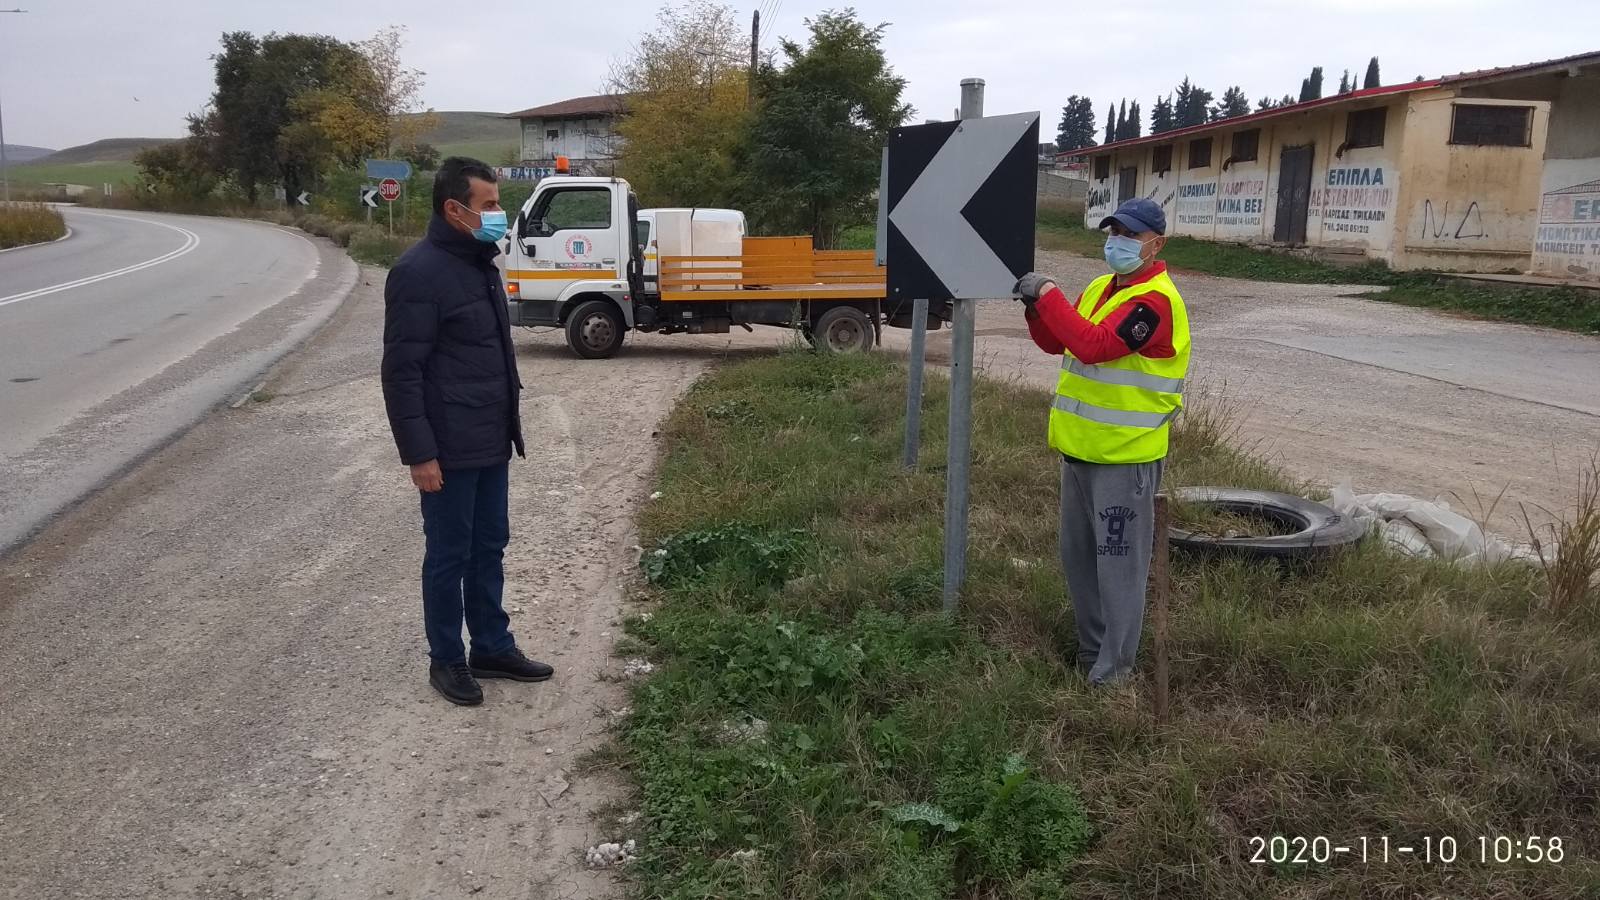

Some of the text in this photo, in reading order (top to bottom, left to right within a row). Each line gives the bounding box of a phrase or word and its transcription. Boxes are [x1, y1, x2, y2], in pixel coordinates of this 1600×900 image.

[1328, 168, 1384, 186] ΕΠΙΠΛΑ
[381, 183, 398, 195] STOP
[1217, 199, 1241, 213] ΚΛΙΜΑ
[1352, 209, 1386, 222] ΤΡΙΚΑΛΩΝ
[1098, 505, 1137, 522] ACTION
[1106, 514, 1126, 546] 9
[1097, 545, 1130, 556] SPORT
